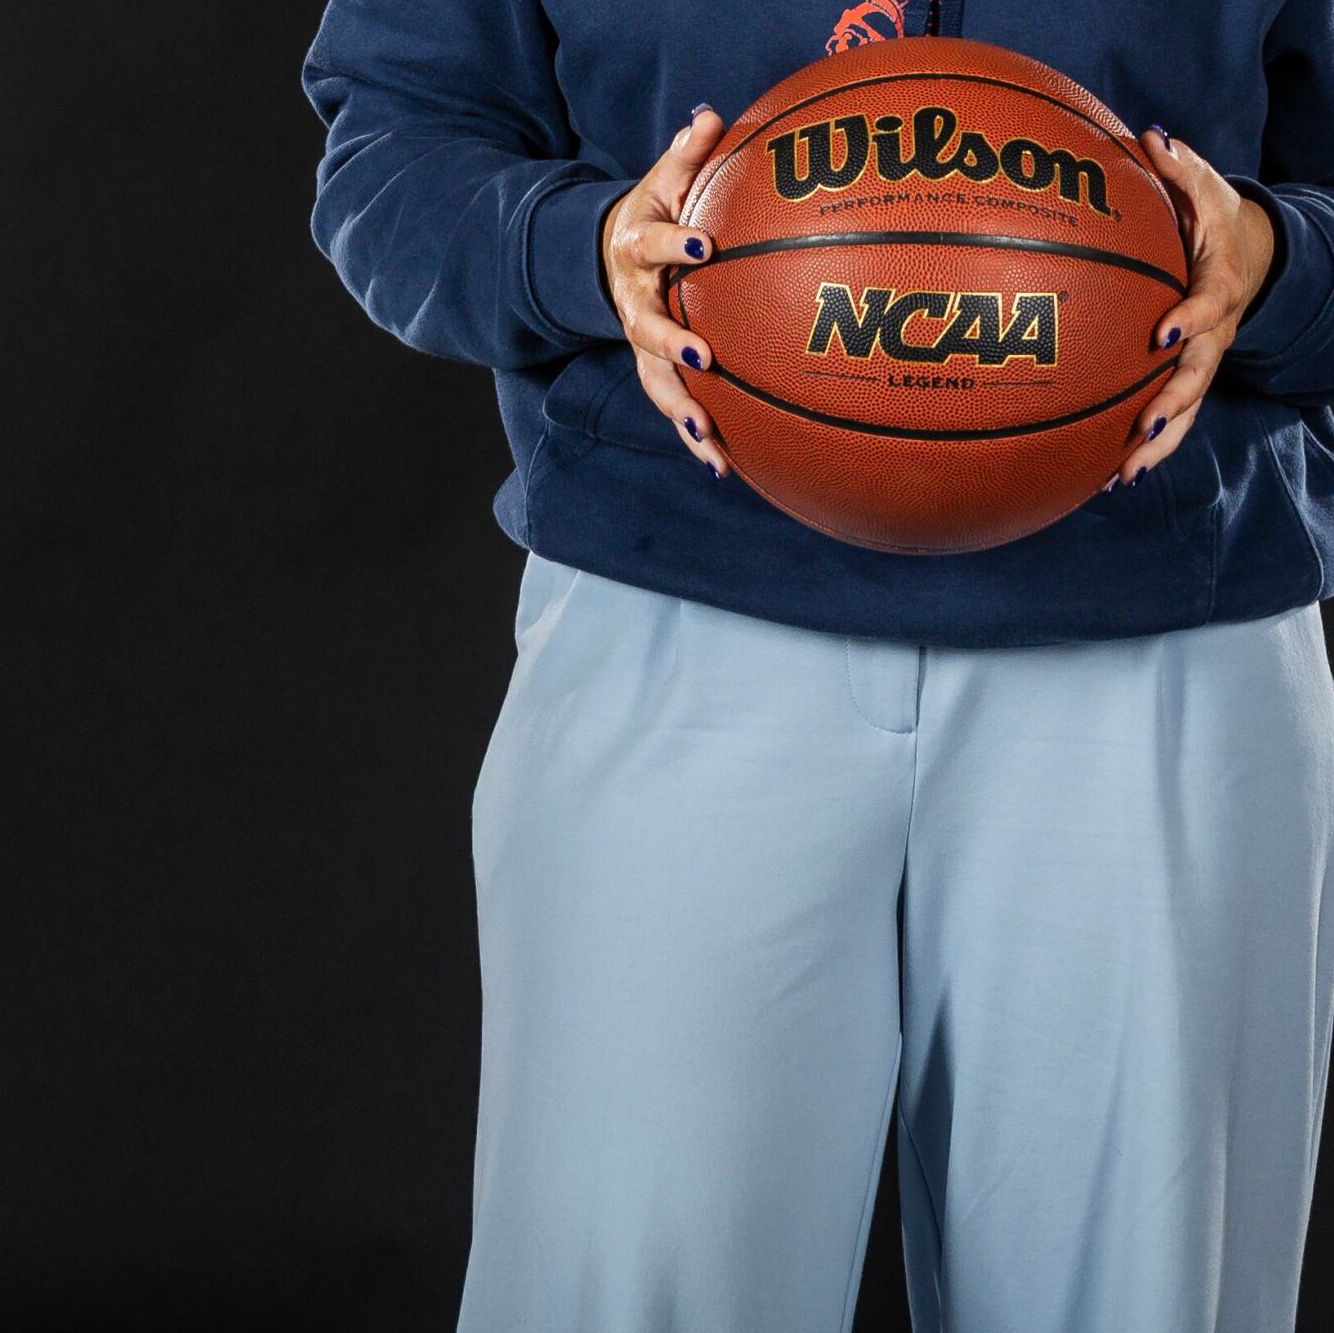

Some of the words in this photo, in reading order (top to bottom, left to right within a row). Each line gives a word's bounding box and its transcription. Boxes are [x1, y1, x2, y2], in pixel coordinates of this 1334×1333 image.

[767, 106, 1112, 217] Wilson
[819, 192, 967, 216] PERFORMANCE
[974, 194, 1078, 227] COMPOSITE
[805, 282, 1058, 368] NCAA
[888, 374, 976, 392] LEGEND
